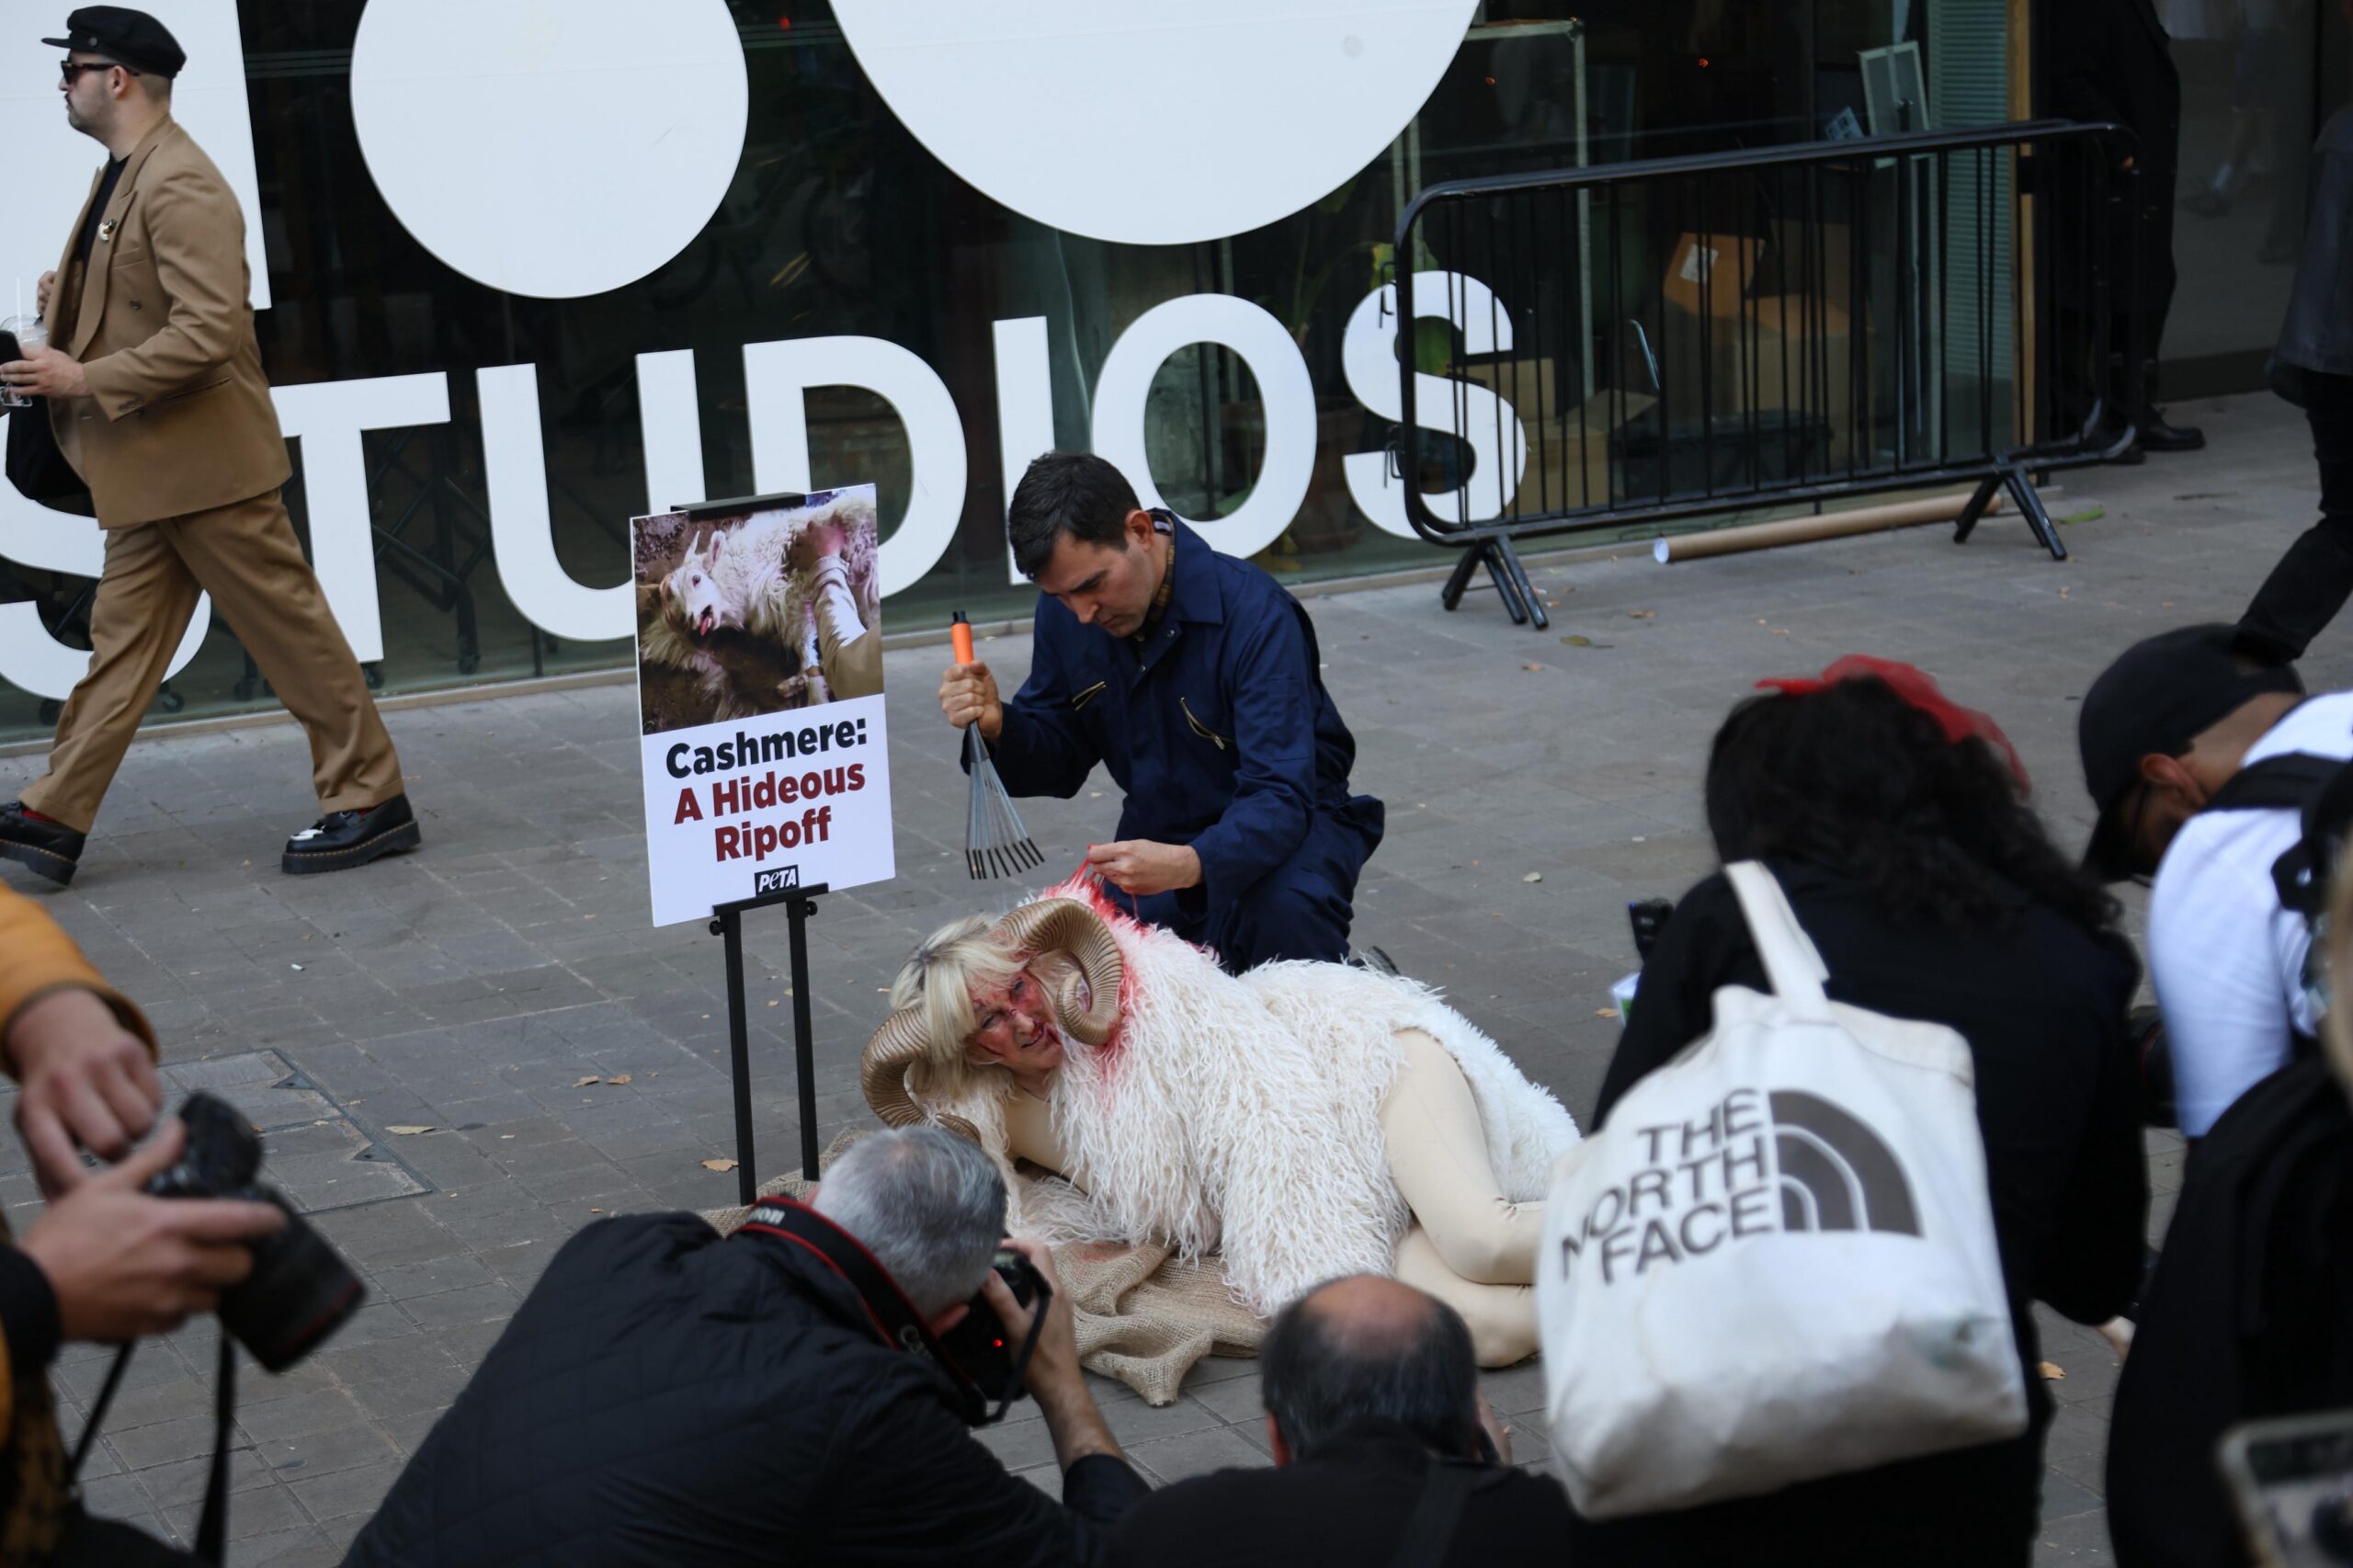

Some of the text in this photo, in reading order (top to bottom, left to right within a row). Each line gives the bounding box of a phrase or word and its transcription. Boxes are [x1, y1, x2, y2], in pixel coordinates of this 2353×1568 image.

[665, 718, 867, 779] Cashmere:
[674, 763, 866, 824] A Hideous
[715, 806, 832, 862] Ripoff
[1637, 1087, 1764, 1165] THE
[1561, 1135, 1767, 1283] NORTH
[1601, 1186, 1776, 1286] FACE
